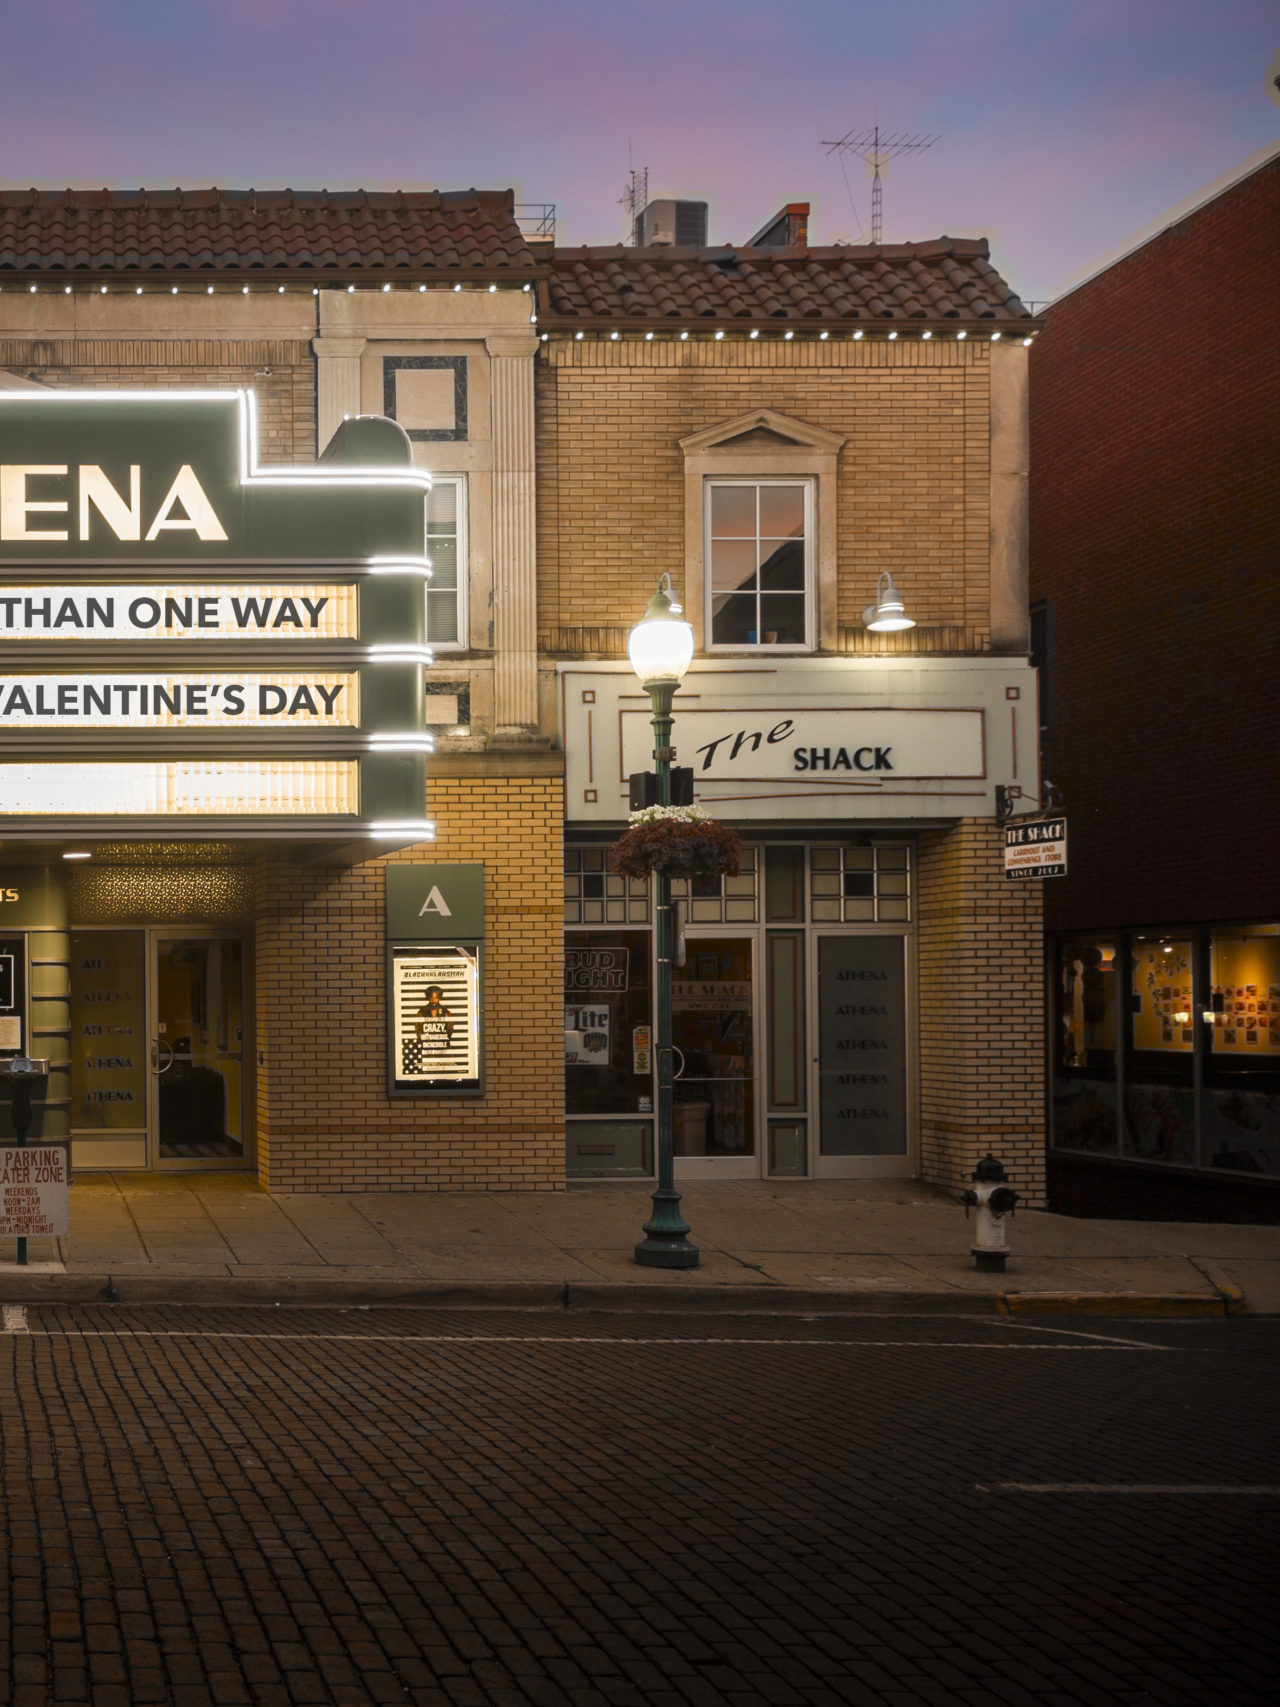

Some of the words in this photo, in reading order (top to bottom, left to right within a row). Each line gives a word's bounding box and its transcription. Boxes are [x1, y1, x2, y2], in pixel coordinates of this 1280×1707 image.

[127, 597, 220, 629] ONE
[227, 597, 330, 629] WAY
[259, 684, 344, 716] DAY
[696, 719, 795, 771] The
[793, 747, 894, 772] SHACK
[1007, 828, 1024, 844] THE
[1027, 824, 1064, 841] SHACK
[418, 885, 453, 917] A
[565, 951, 616, 969] BUD
[565, 970, 625, 988] IGHT
[835, 971, 889, 981] ATHENA
[573, 1004, 609, 1033] Lite
[836, 1005, 889, 1015] ATHENA
[836, 1039, 889, 1050] ATHENA
[836, 1074, 889, 1085] ATHENA
[837, 1108, 890, 1120] ATHENA
[5, 1150, 60, 1167] PARKING
[34, 1167, 64, 1183] ZONE
[4, 1187, 39, 1197] WEEKENDS
[5, 1206, 40, 1215] WEEKDAYS
